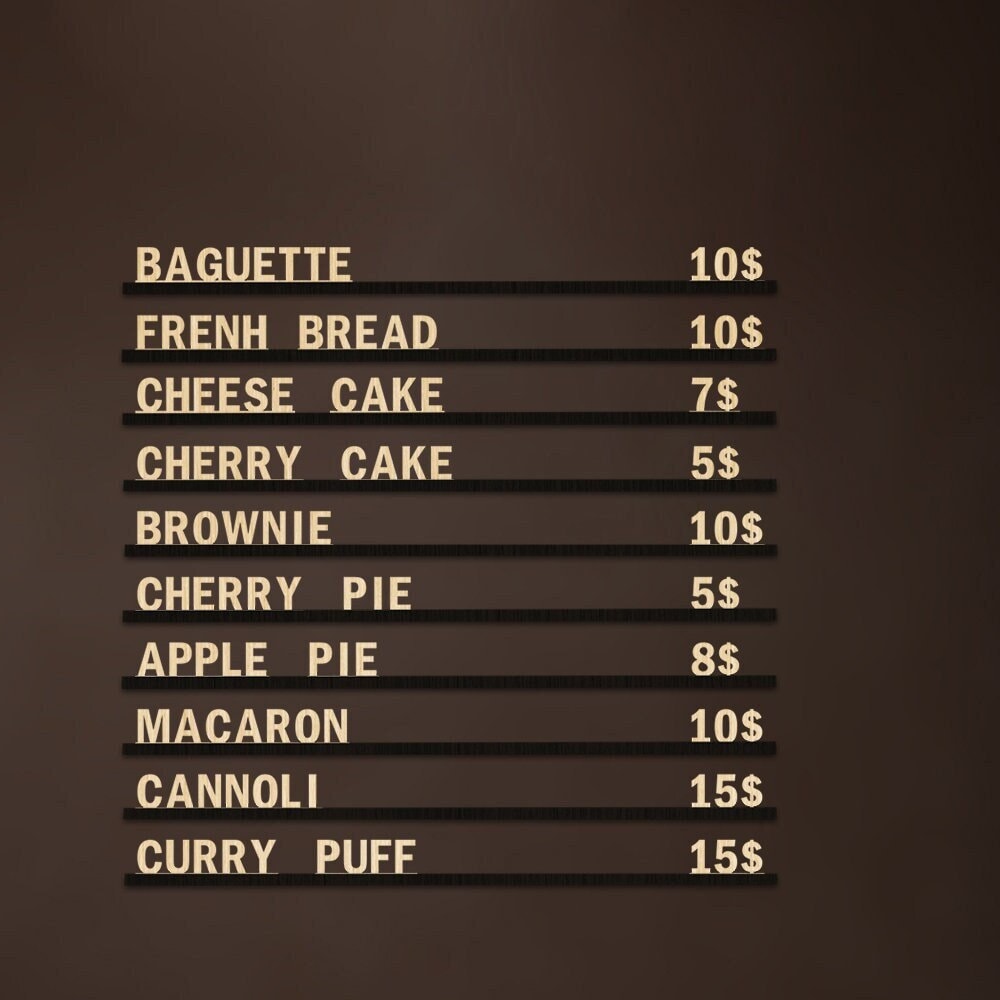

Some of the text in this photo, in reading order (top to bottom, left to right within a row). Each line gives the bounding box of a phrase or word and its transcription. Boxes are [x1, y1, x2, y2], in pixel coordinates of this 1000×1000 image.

[135, 247, 762, 282] BAGUETTE 10$
[136, 315, 762, 350] FRENH BREAD 10$
[135, 377, 739, 413] CHEESE CAKE 7$
[136, 446, 739, 480] CHERRY CAKE 5$
[137, 511, 762, 545] BROWNIE 10$
[137, 577, 739, 610] CHERRY PIE 5$
[137, 642, 739, 677] APPLE PIE 8$
[136, 709, 762, 743] MACARON 10$
[137, 774, 762, 808] CANNOLI 15$
[136, 840, 764, 874] CURRY PUFF 15$
